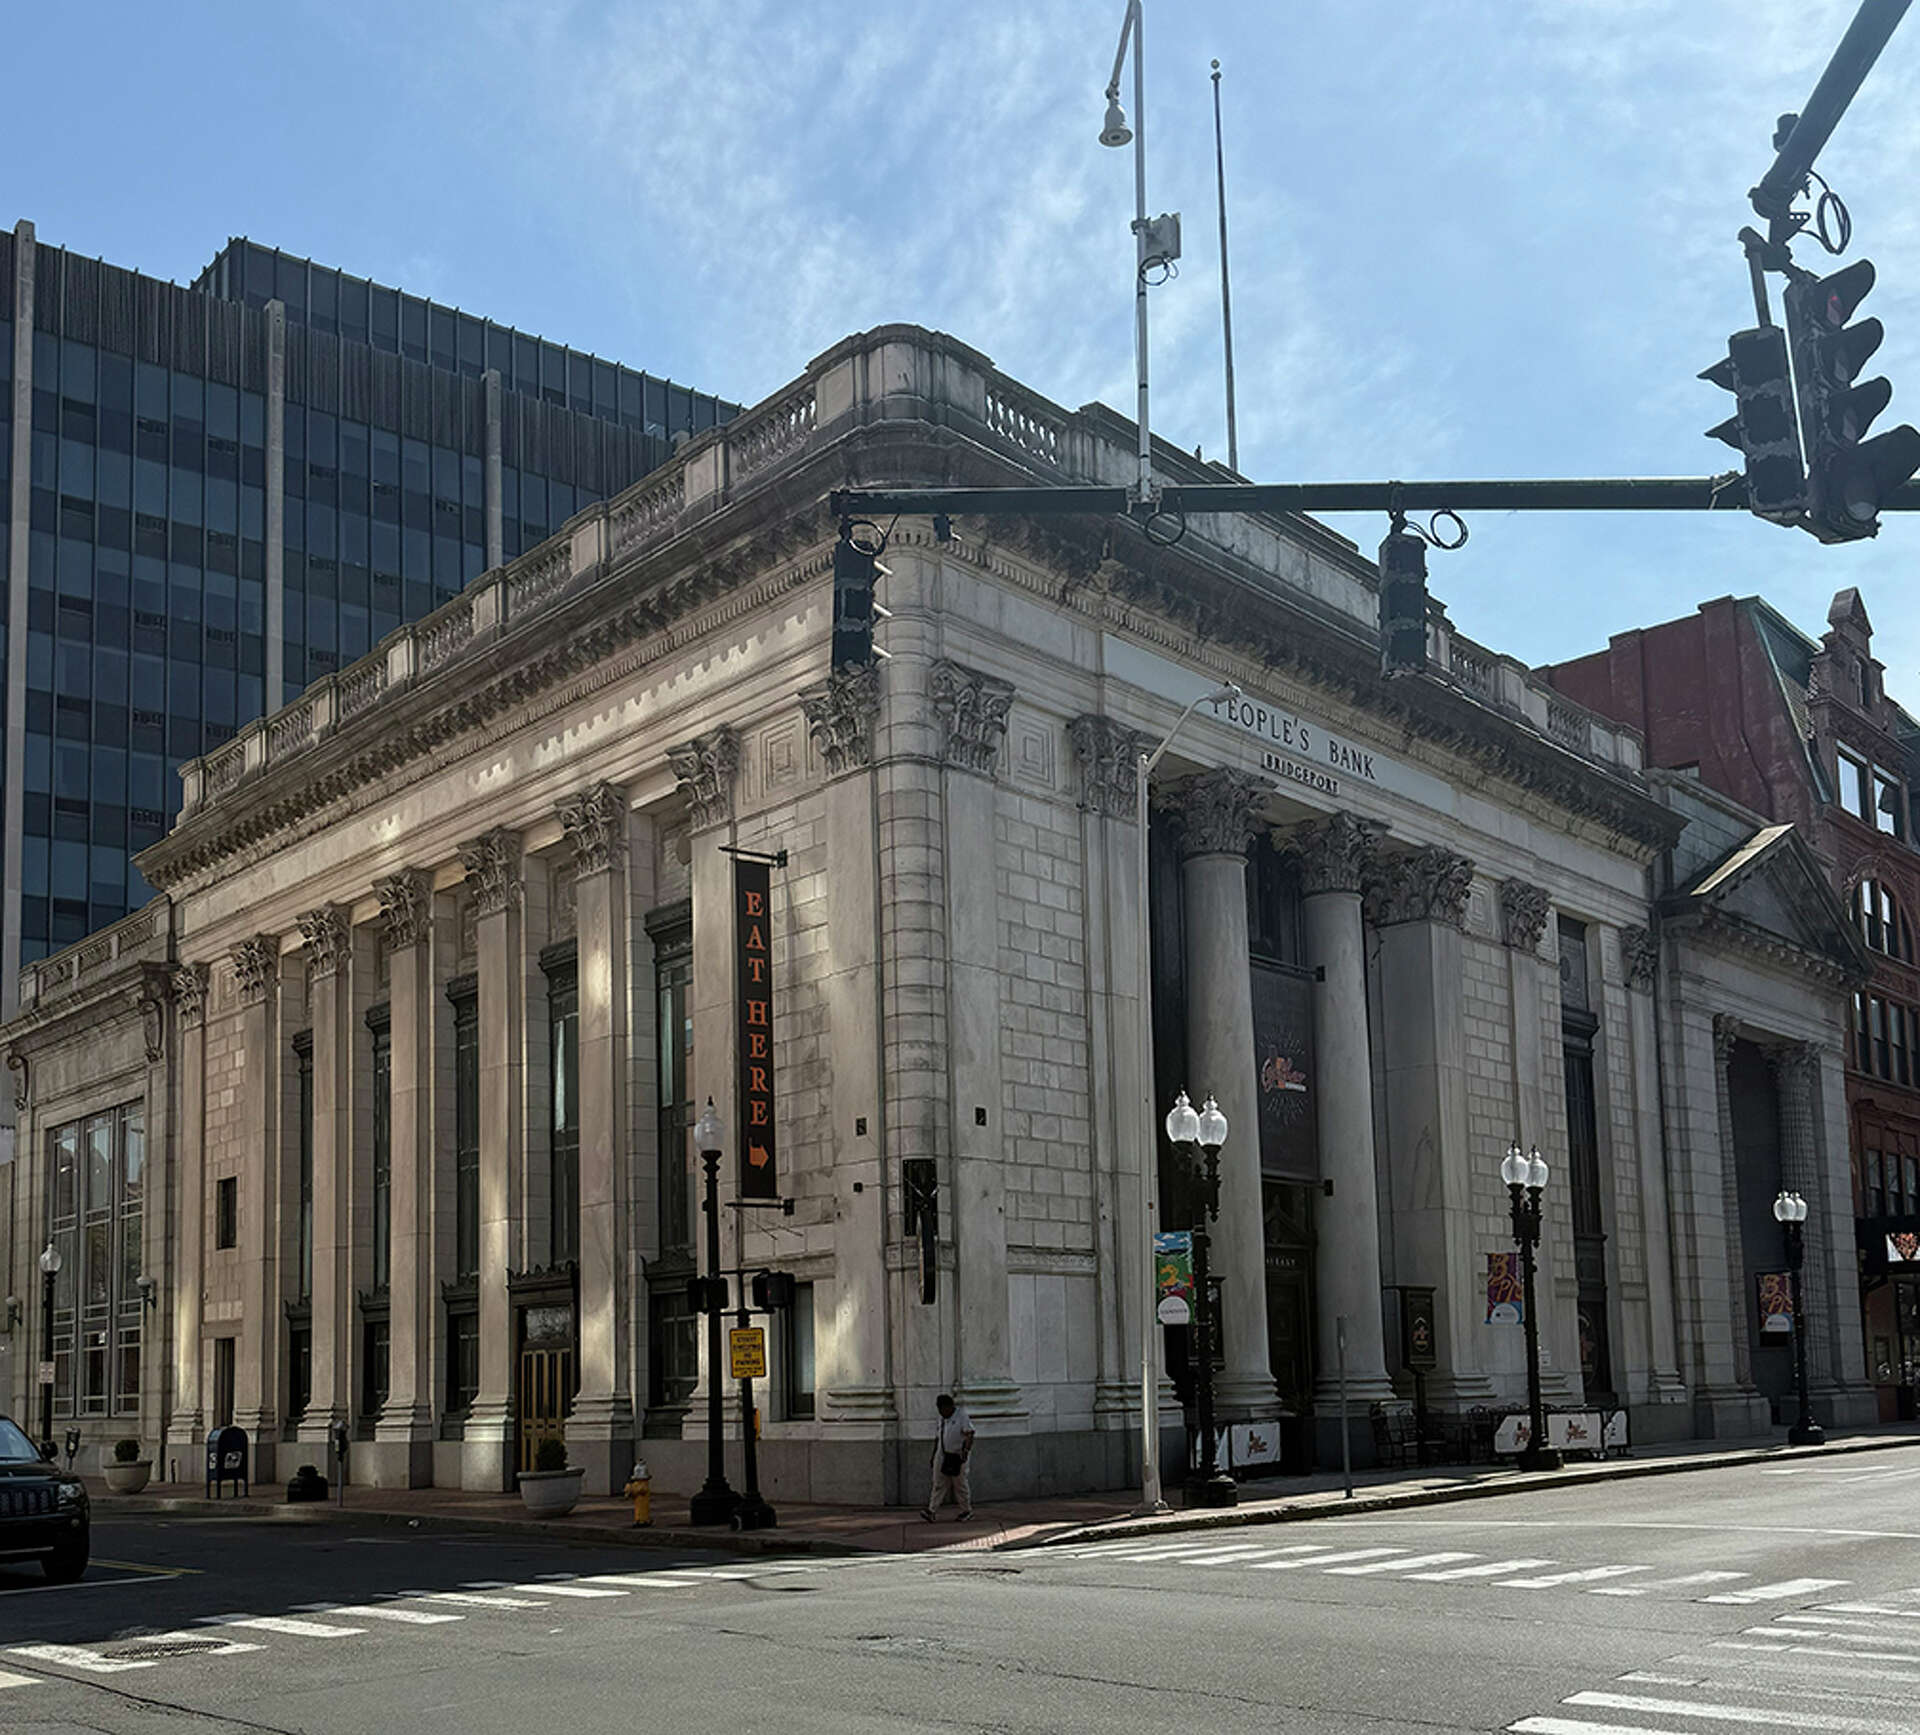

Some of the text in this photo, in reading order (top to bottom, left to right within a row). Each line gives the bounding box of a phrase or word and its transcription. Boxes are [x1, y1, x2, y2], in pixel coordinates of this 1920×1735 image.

[1328, 739, 1376, 780] BANK
[744, 890, 769, 1126] EAT HERE
